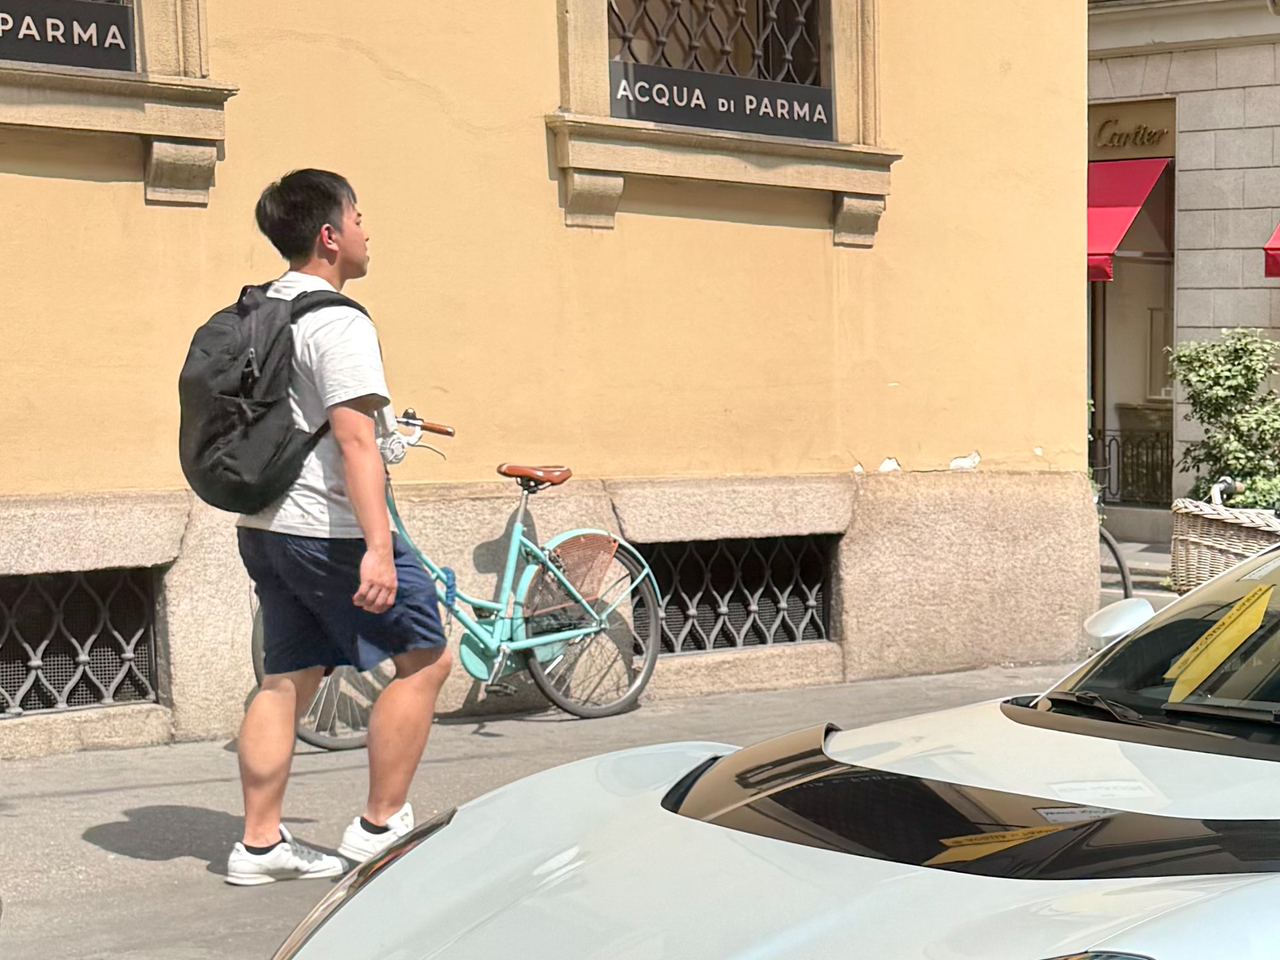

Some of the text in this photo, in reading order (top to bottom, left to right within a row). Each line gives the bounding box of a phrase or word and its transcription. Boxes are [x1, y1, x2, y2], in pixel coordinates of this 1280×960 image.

[0, 13, 126, 50] PARMA
[616, 79, 828, 124] ACQUA DI PARMA
[1096, 118, 1169, 148] Cartier
